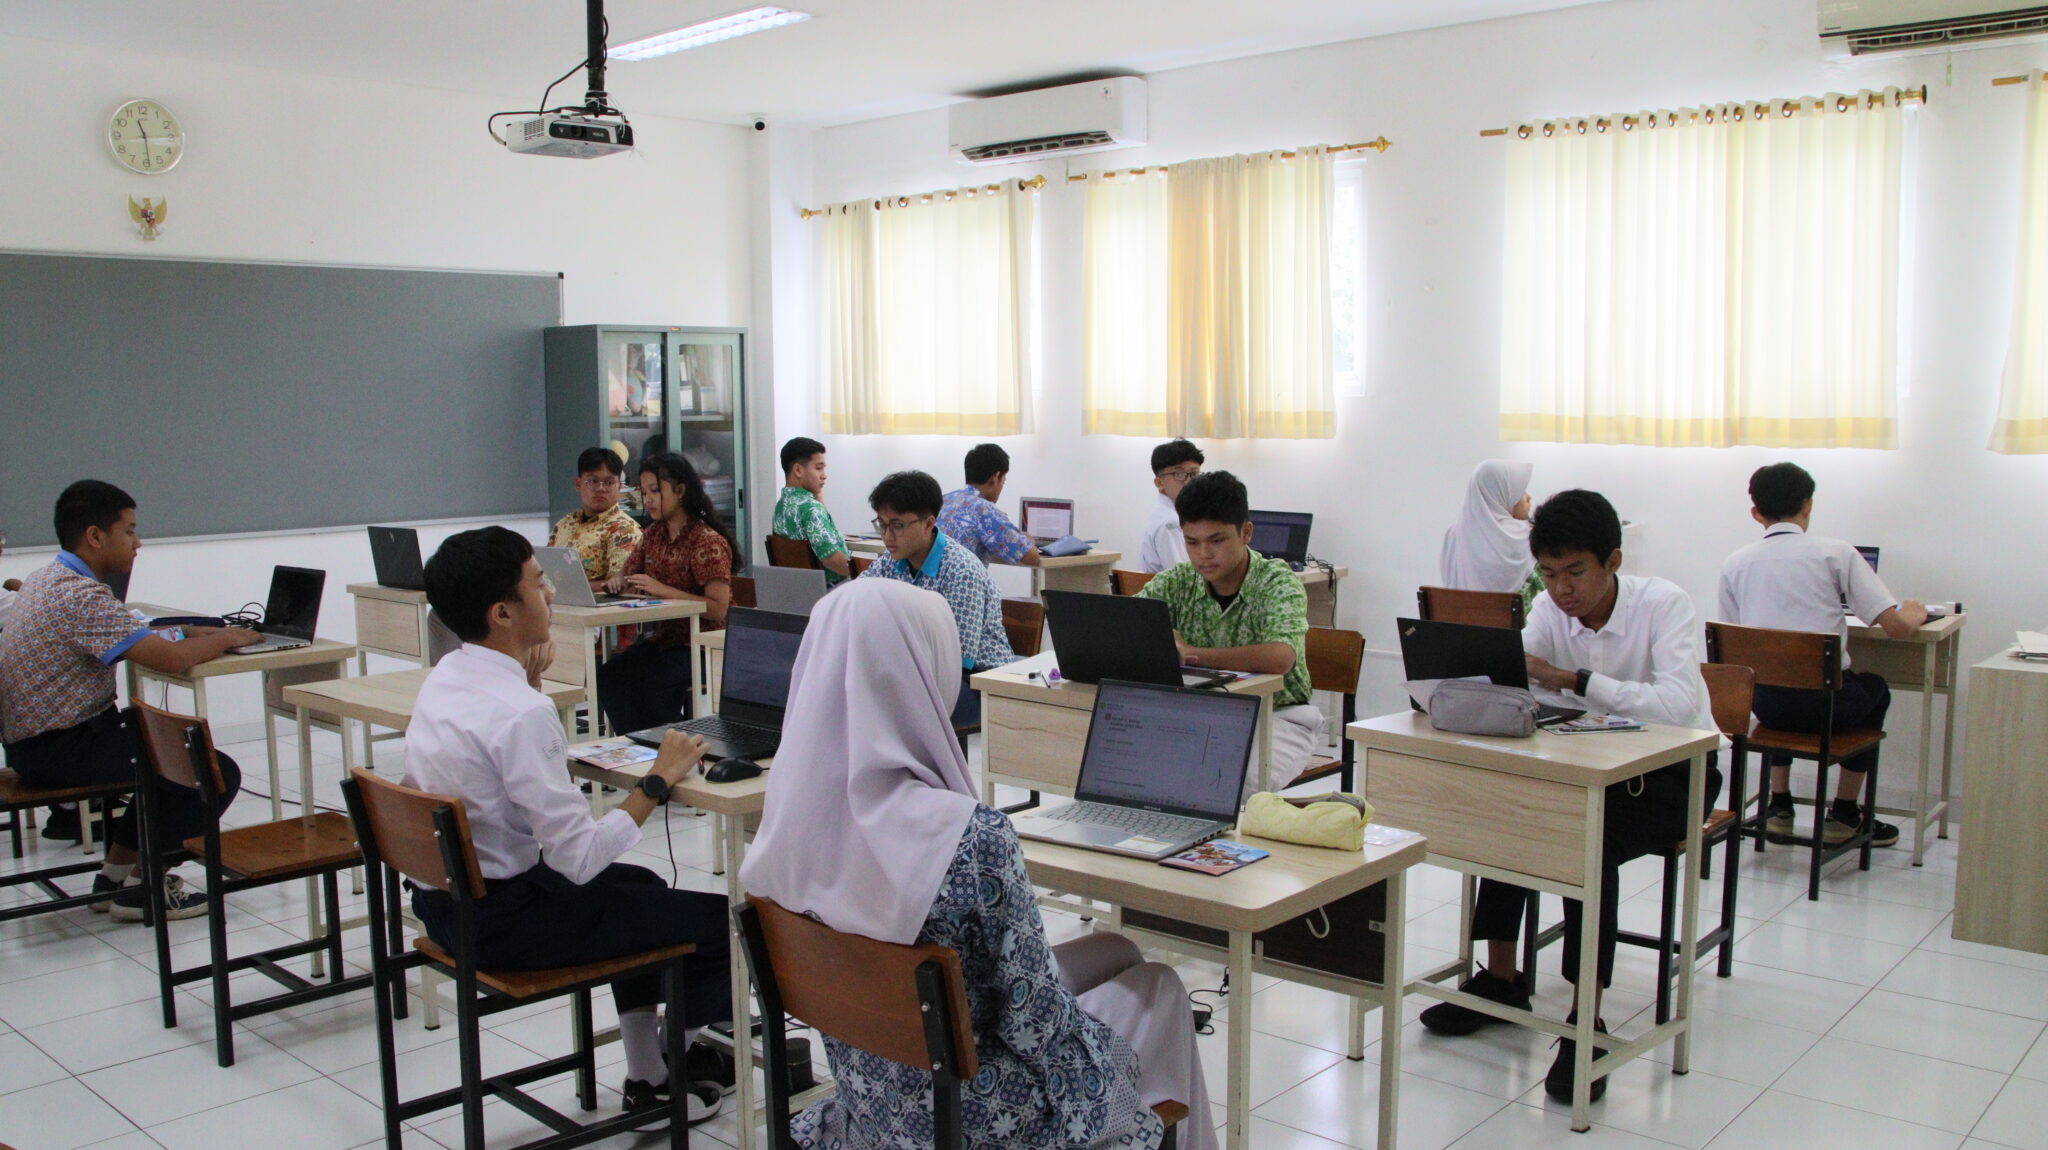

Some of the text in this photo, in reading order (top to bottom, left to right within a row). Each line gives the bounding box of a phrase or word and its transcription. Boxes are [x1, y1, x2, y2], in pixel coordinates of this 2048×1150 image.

[126, 109, 133, 118] 11
[138, 106, 148, 115] 12
[117, 118, 127, 127] 10
[162, 121, 170, 129] 2
[113, 131, 121, 140] 9
[167, 133, 175, 142] 3
[118, 144, 126, 154] 8
[129, 154, 136, 163] 7
[142, 159, 151, 167] 6
[156, 155, 164, 164] 5
